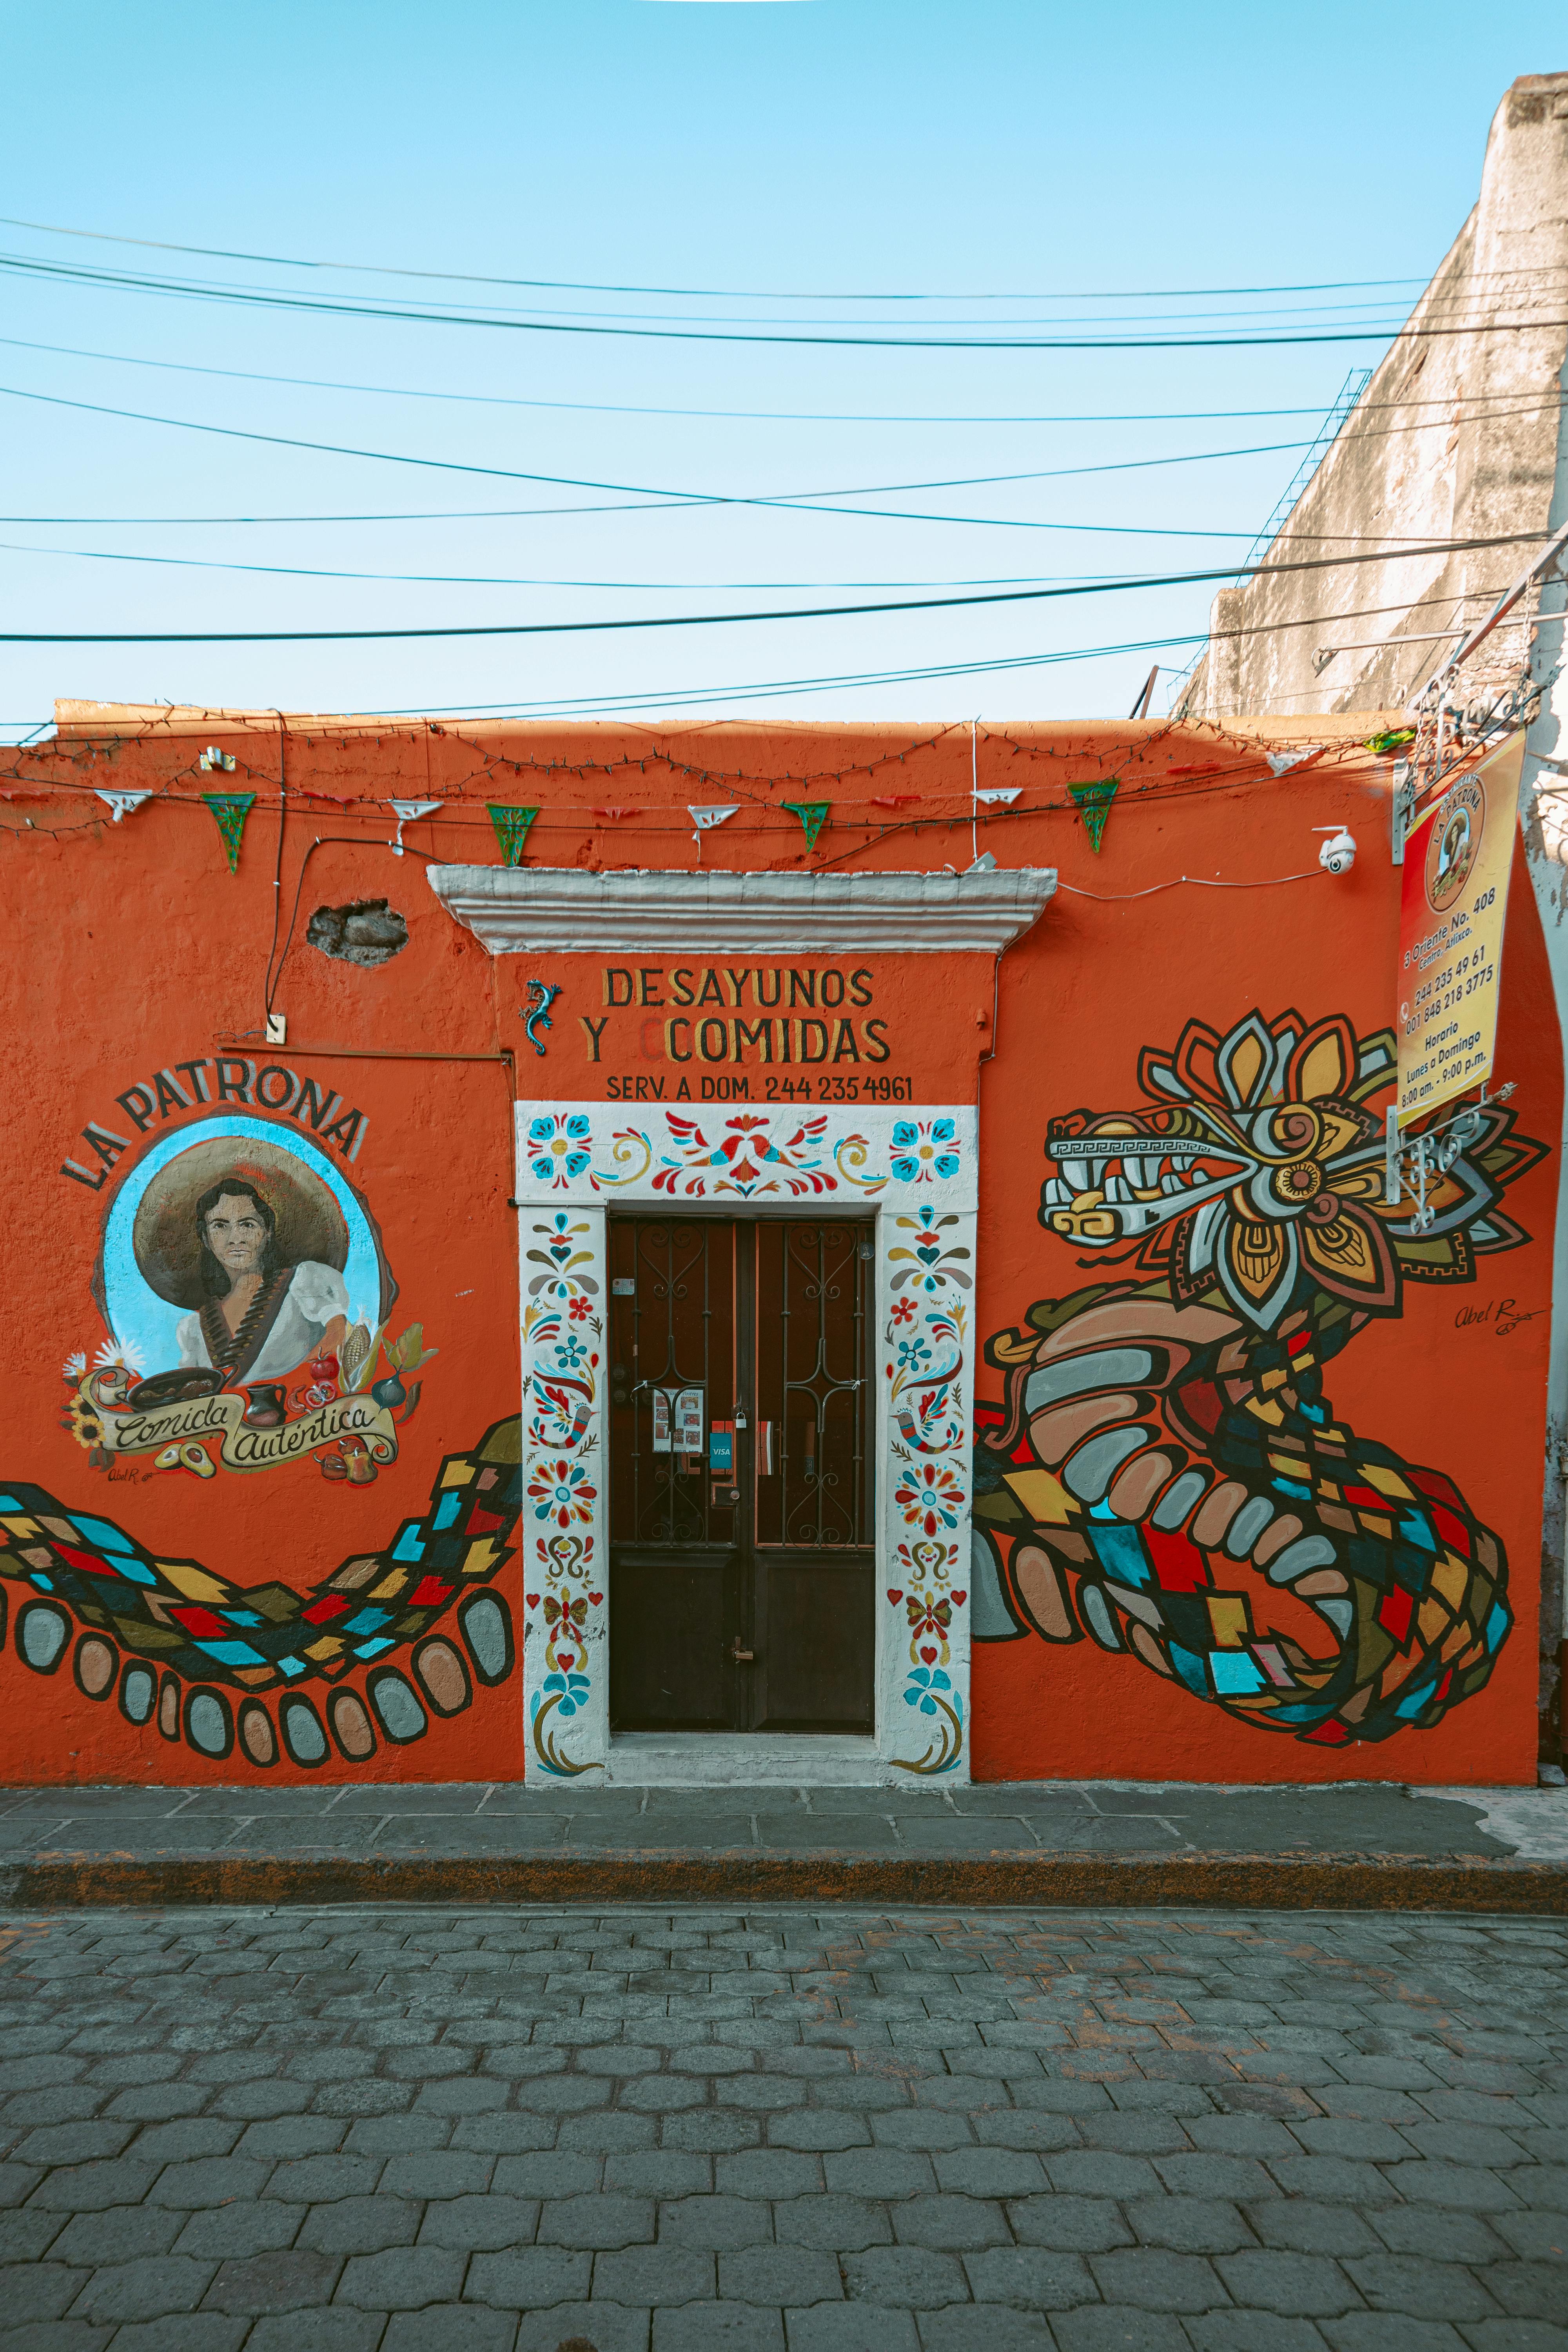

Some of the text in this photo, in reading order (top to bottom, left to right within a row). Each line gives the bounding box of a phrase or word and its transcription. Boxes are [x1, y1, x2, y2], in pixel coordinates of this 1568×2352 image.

[1434, 787, 1481, 844] LA PATRONA
[1405, 887, 1495, 968] 3 Oriente No. 408
[1419, 927, 1472, 970] Centro, Atlixco.
[604, 967, 874, 1008] DESAYUNOS
[1406, 964, 1493, 1035] 001 848 218 3775
[1415, 945, 1485, 1007] 244 235 49 61
[583, 1017, 891, 1063] Y COMIDAS
[1407, 1031, 1481, 1084] Lunes a Domingo
[1425, 1021, 1458, 1052] Horario
[606, 1076, 912, 1101] SERV. A DOM. 244 235 4961
[1402, 1087, 1417, 1108] 8:00
[1420, 1082, 1434, 1097] am.
[1443, 1060, 1462, 1083] 9:00
[1465, 1052, 1486, 1075] p.m.
[60, 1057, 369, 1191] LA PATRONA
[115, 1397, 228, 1448] Comida
